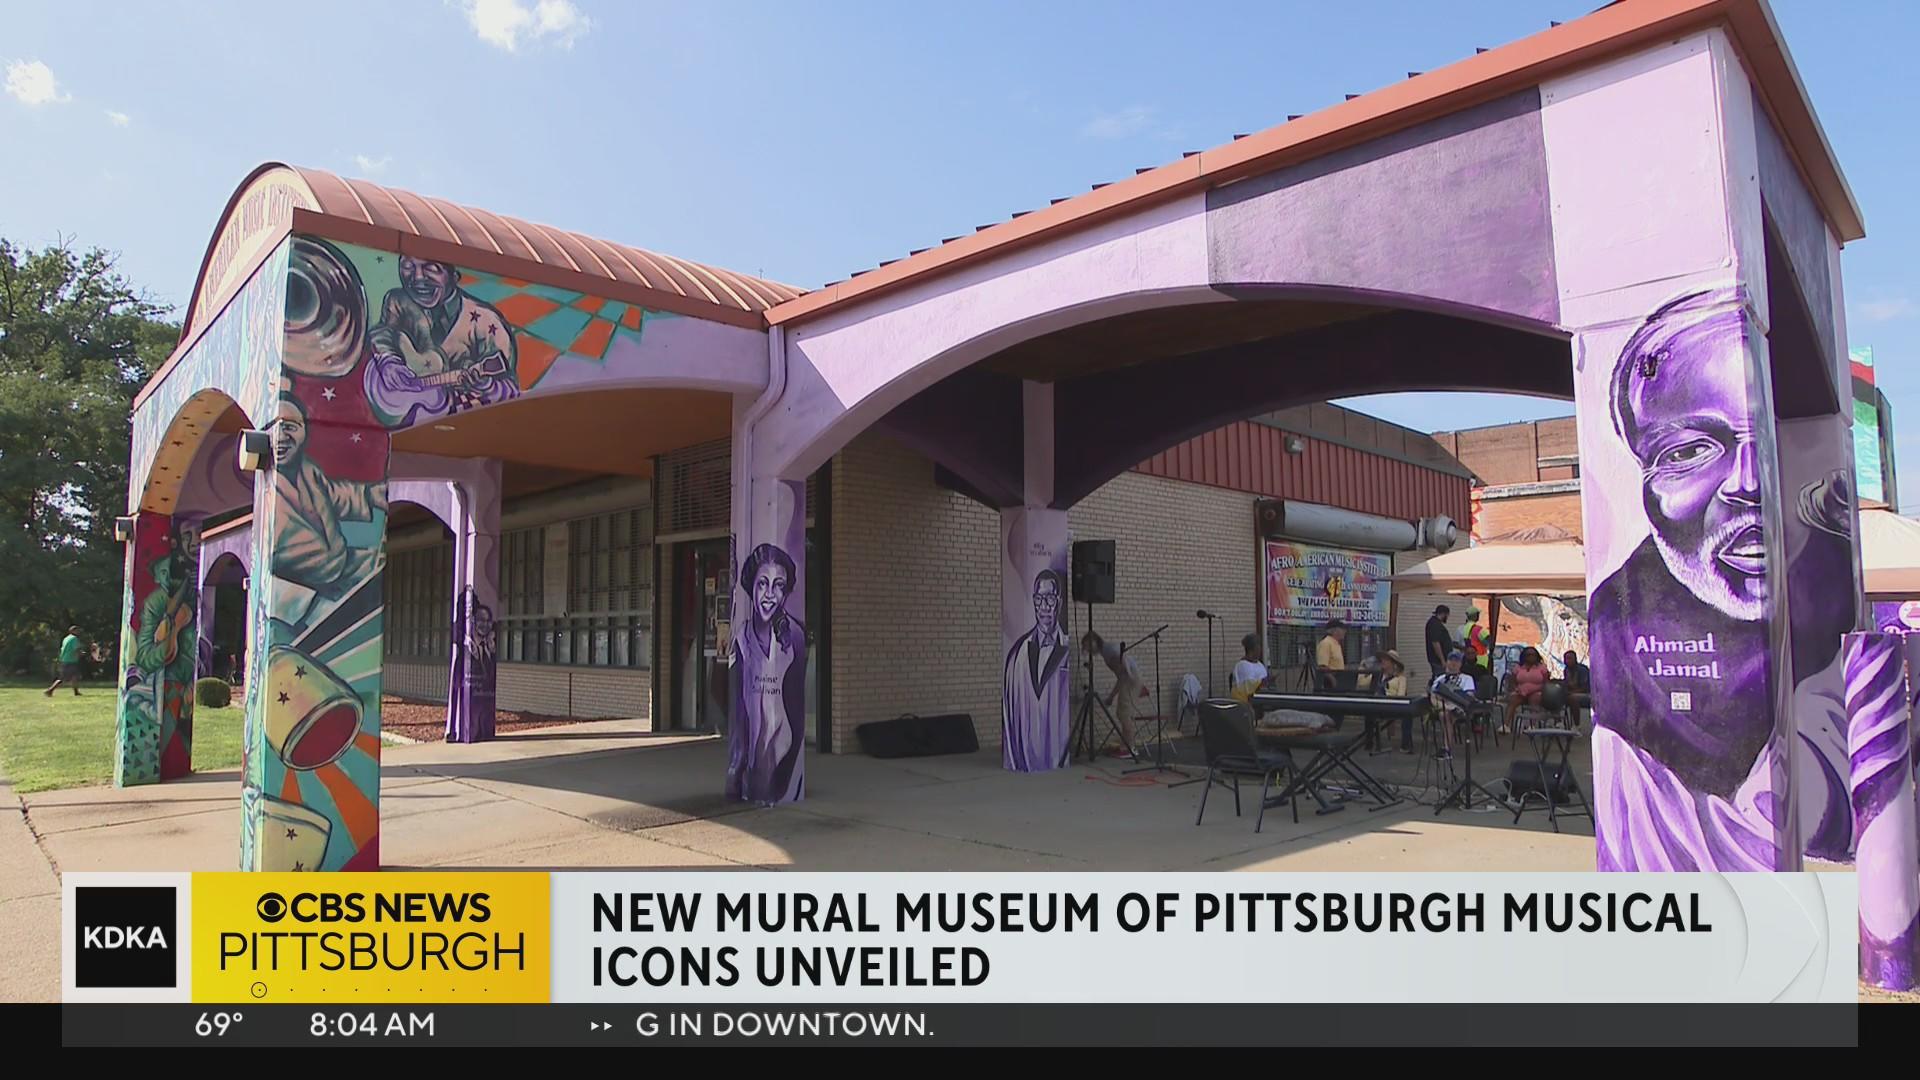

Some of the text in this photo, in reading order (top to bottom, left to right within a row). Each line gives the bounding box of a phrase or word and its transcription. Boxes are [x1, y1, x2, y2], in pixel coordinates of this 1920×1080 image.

[1272, 554, 1295, 571] AFRO
[1310, 597, 1328, 607] PLACE
[1633, 632, 1717, 653] Ahmad
[1648, 658, 1722, 679] Jamal
